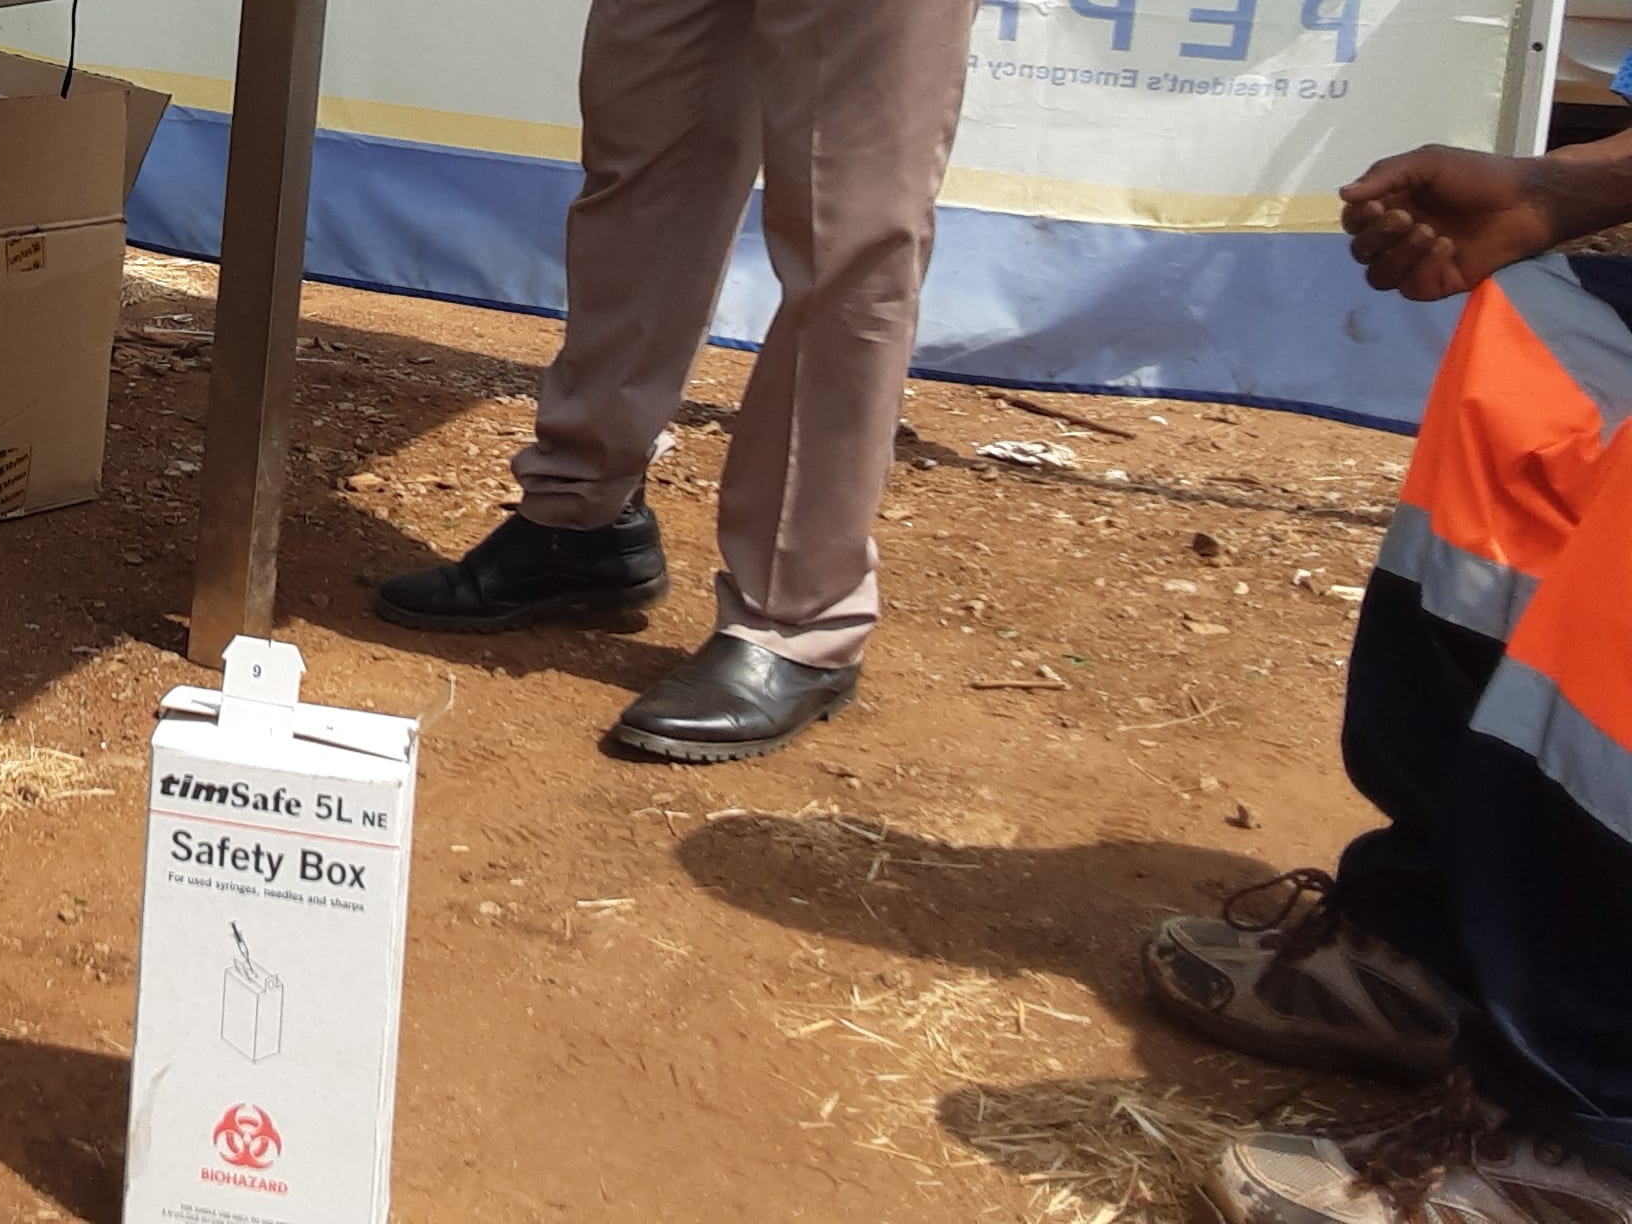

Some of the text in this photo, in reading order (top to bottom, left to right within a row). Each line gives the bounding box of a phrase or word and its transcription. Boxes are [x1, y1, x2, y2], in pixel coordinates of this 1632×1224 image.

[314, 793, 353, 824] 5L
[361, 810, 388, 829] NE
[170, 828, 367, 890] Safety Box
[168, 870, 184, 883] For
[187, 874, 212, 888] used
[263, 887, 304, 902] needles
[306, 893, 327, 906] and
[329, 896, 365, 913] sharps
[199, 1166, 289, 1195] BIOHAZARD
